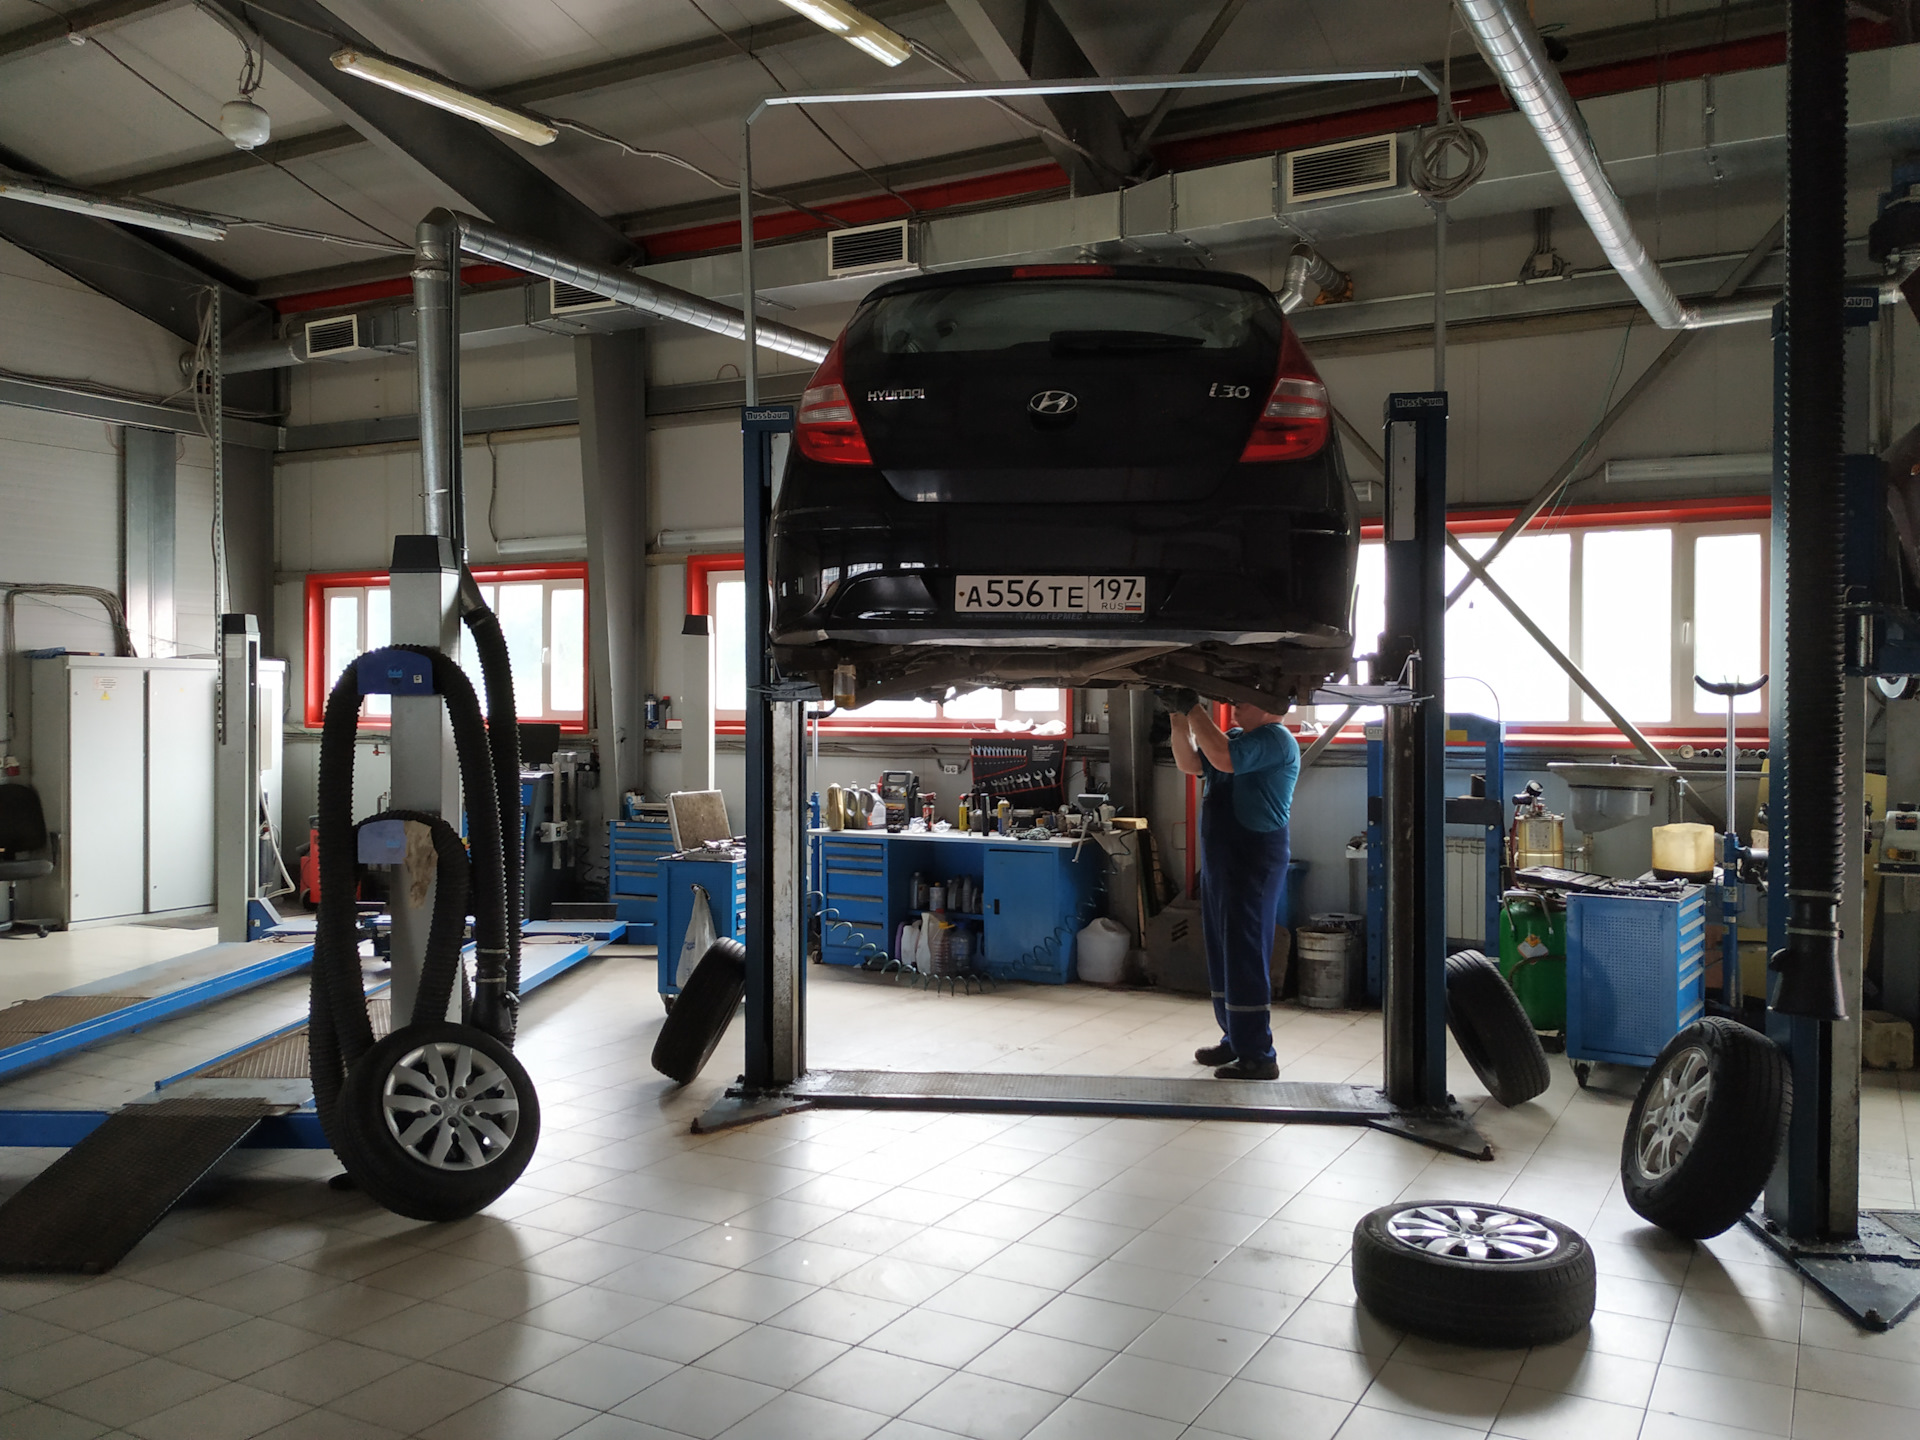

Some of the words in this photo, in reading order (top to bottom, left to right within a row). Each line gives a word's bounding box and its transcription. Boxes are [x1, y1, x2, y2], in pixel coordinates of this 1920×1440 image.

[867, 388, 926, 402] HYUNDAI
[1094, 578, 1137, 601] 197
[1101, 602, 1125, 610] RUS
